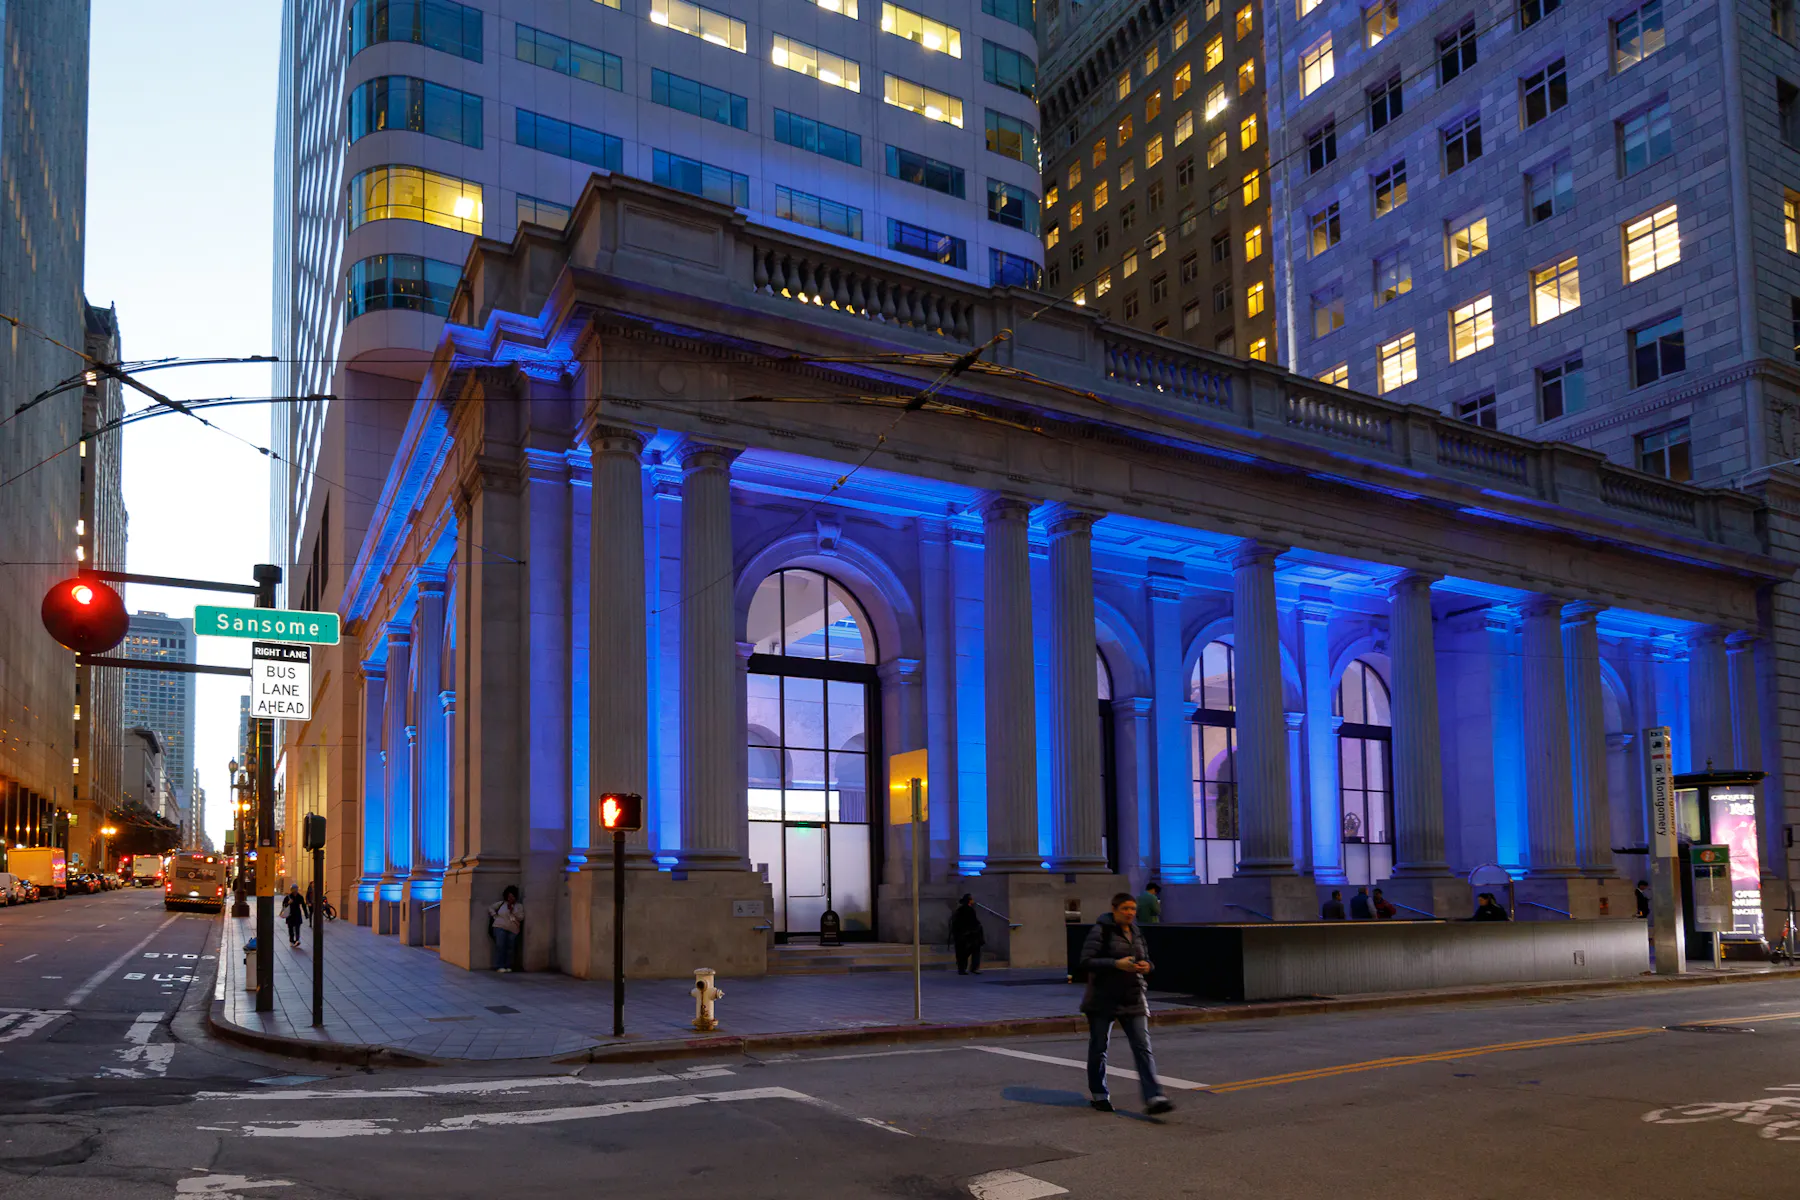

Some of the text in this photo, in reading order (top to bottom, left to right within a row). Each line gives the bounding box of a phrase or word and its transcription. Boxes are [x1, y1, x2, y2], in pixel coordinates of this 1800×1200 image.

[216, 613, 320, 636] Sansome
[255, 647, 308, 660] RIGHT LANE
[266, 665, 296, 680] BUS
[262, 682, 300, 697] LANE
[258, 700, 305, 715] AHEAD
[1655, 776, 1667, 837] Montgomery
[123, 972, 200, 983] BUS
